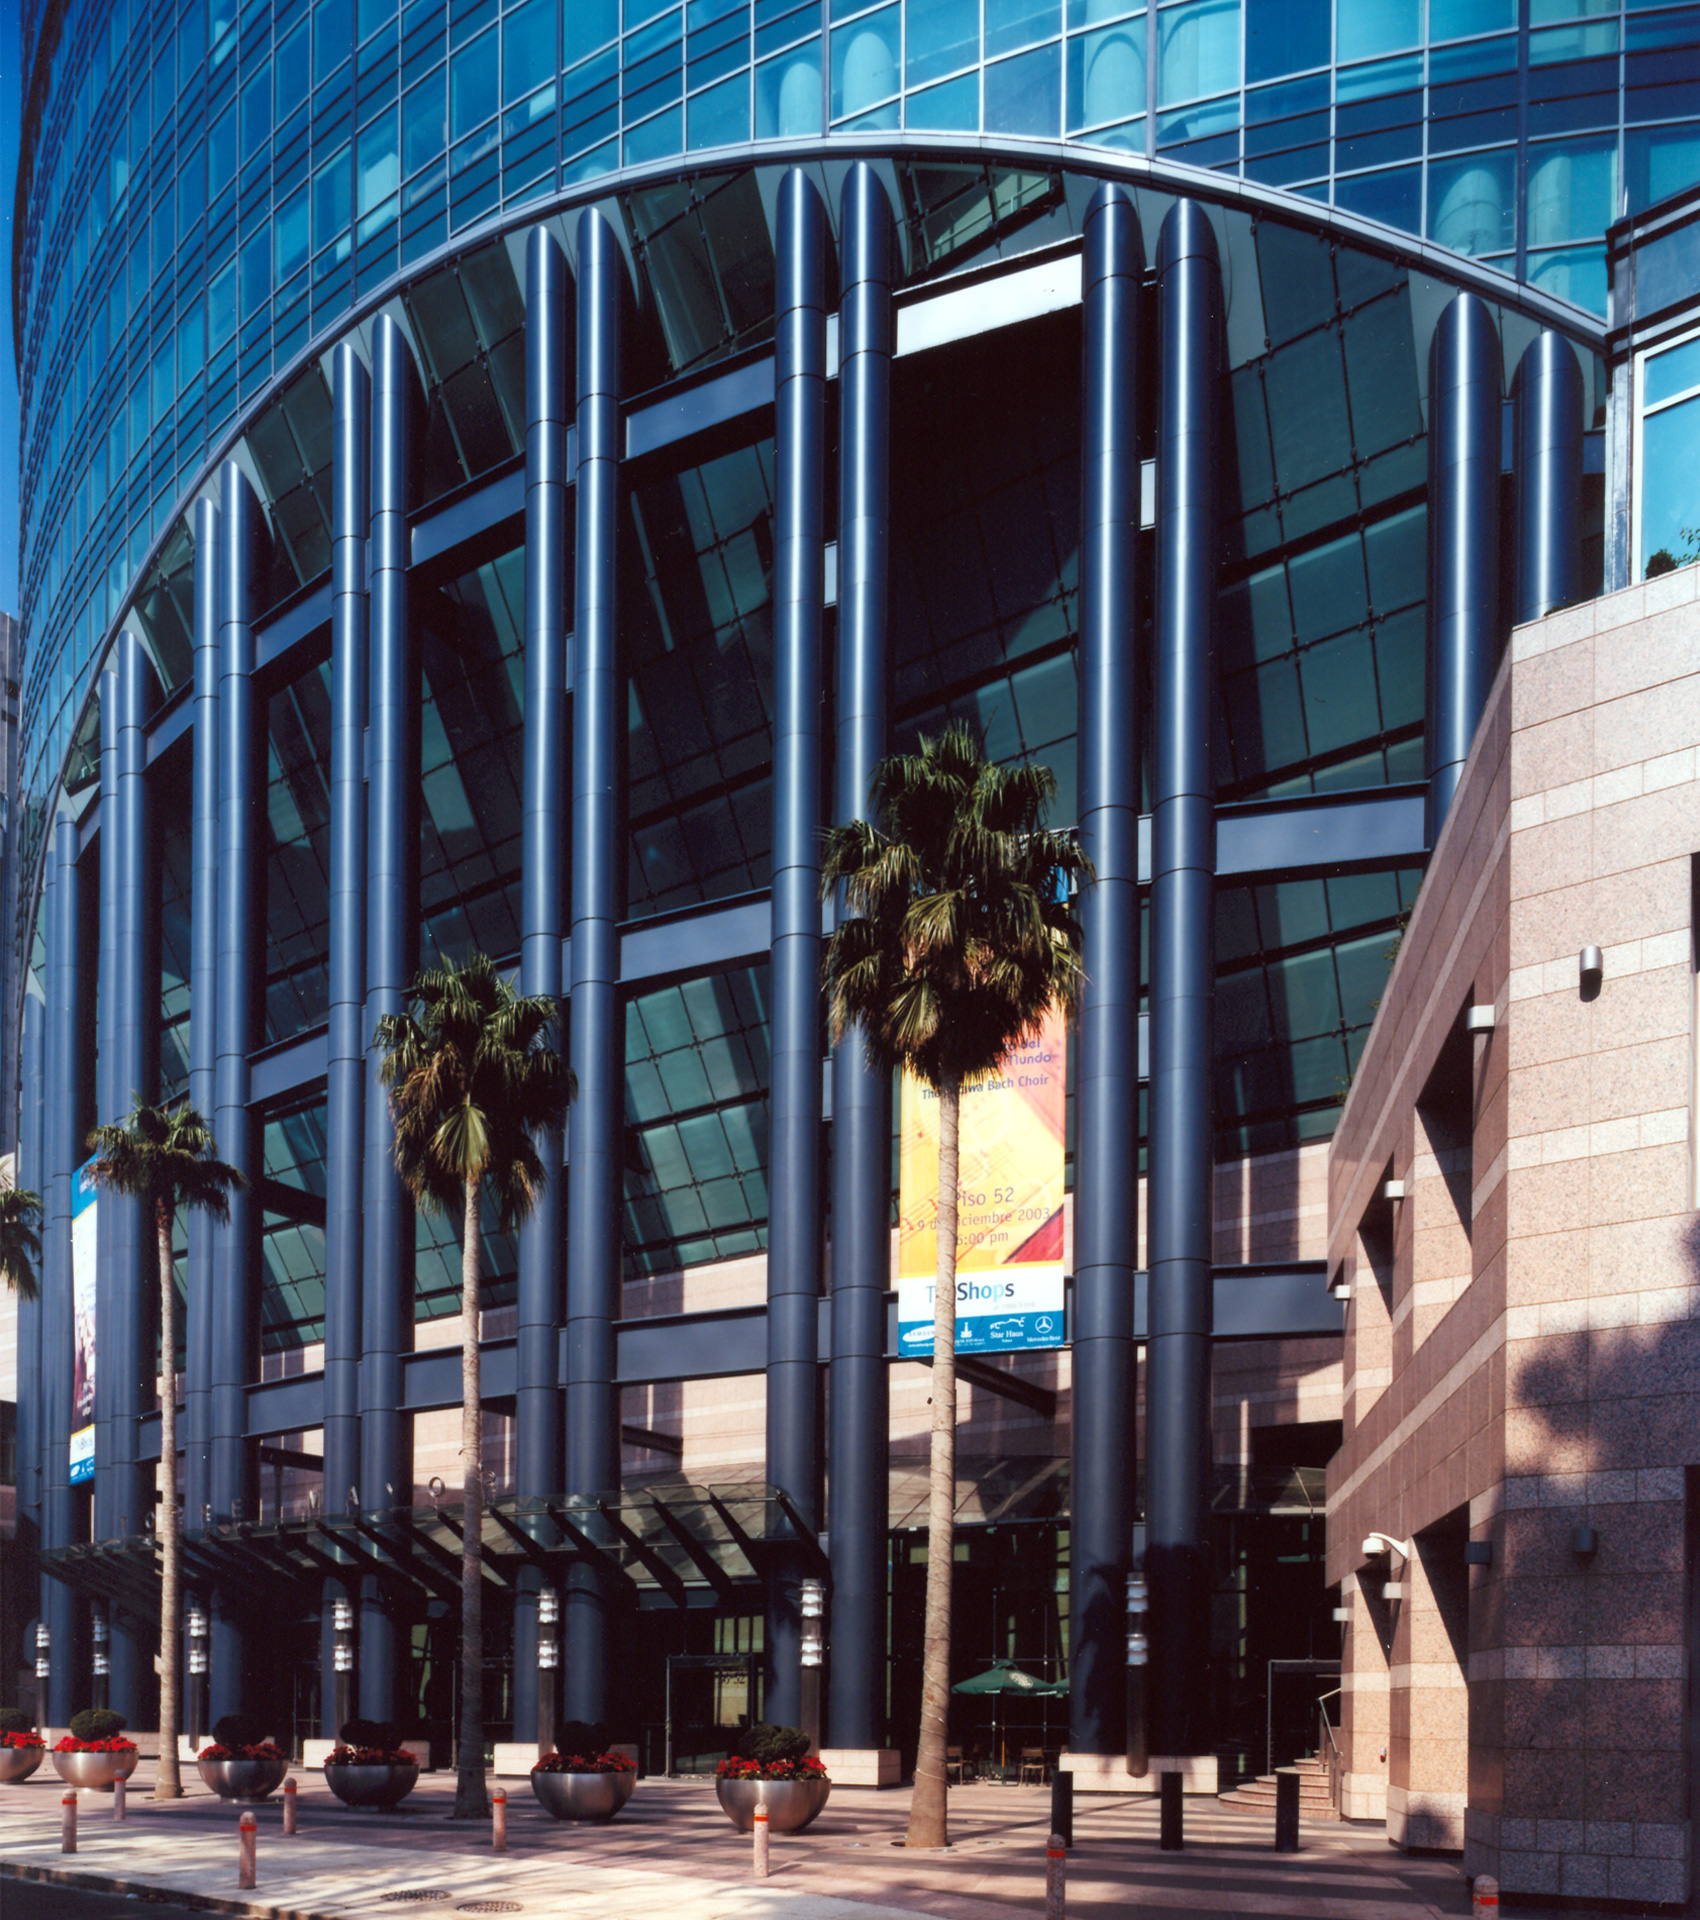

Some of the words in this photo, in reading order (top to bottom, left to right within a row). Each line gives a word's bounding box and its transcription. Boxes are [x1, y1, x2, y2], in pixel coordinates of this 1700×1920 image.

[1020, 1038, 1041, 1050] del
[1003, 1052, 1052, 1067] Mundo
[987, 1078, 1014, 1091] Bach
[1018, 1074, 1049, 1087] Choir
[994, 1186, 1015, 1203] 52
[917, 1219, 925, 1231] 9
[957, 1212, 1012, 1227] iciembre
[1017, 1207, 1050, 1221] 2003
[956, 1233, 985, 1246] 6:00
[989, 1232, 1009, 1246] pm
[926, 1281, 1015, 1303] TShops
[990, 1331, 1004, 1339] Star
[1006, 1330, 1024, 1338] Haus
